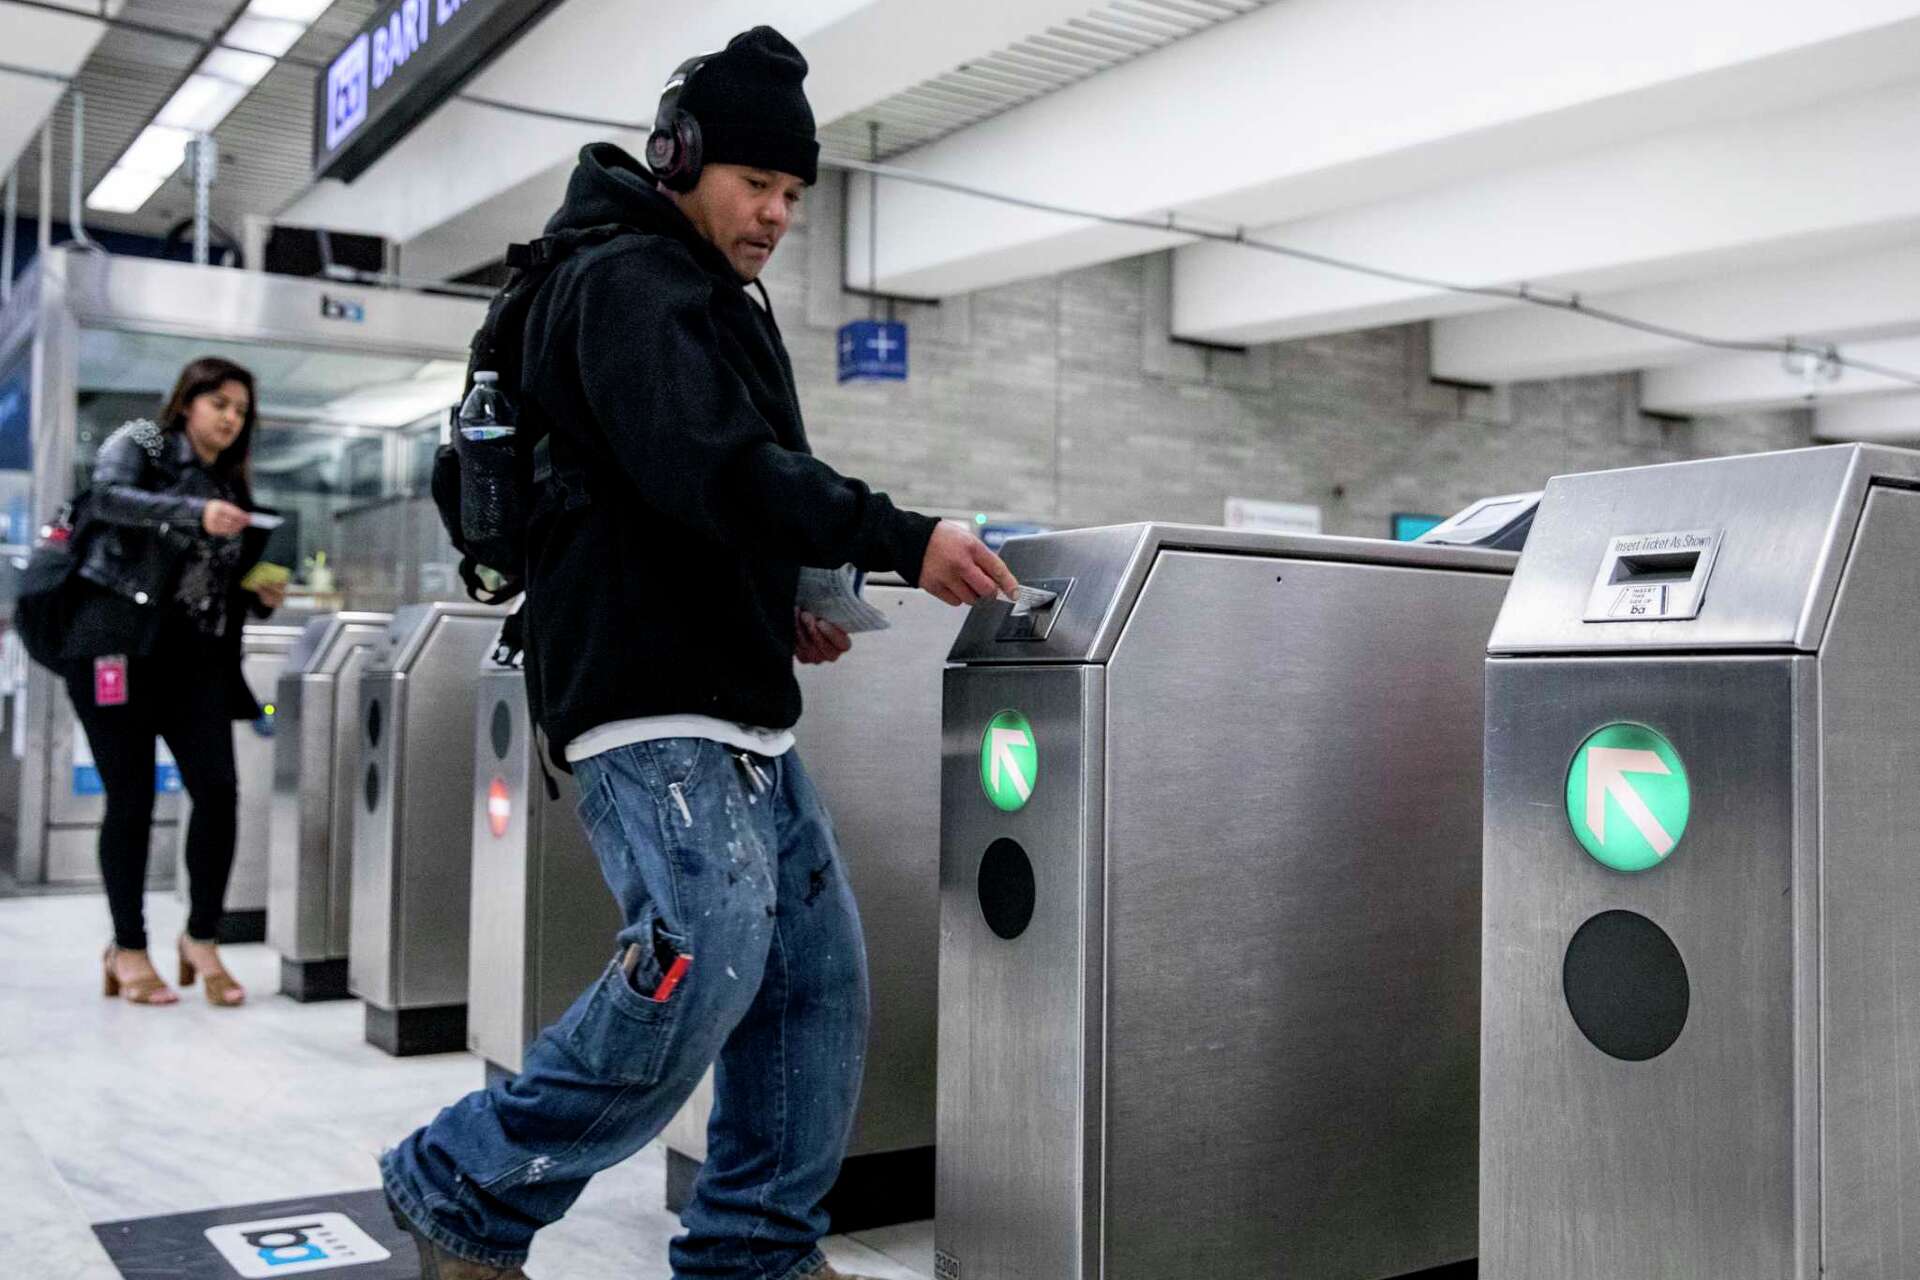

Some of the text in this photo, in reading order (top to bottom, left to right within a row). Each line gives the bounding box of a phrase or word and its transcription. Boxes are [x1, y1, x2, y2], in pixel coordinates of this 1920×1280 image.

[321, 294, 365, 321] ba
[1615, 534, 1712, 552] Insert Ticket As Shown
[1630, 604, 1646, 615] ba
